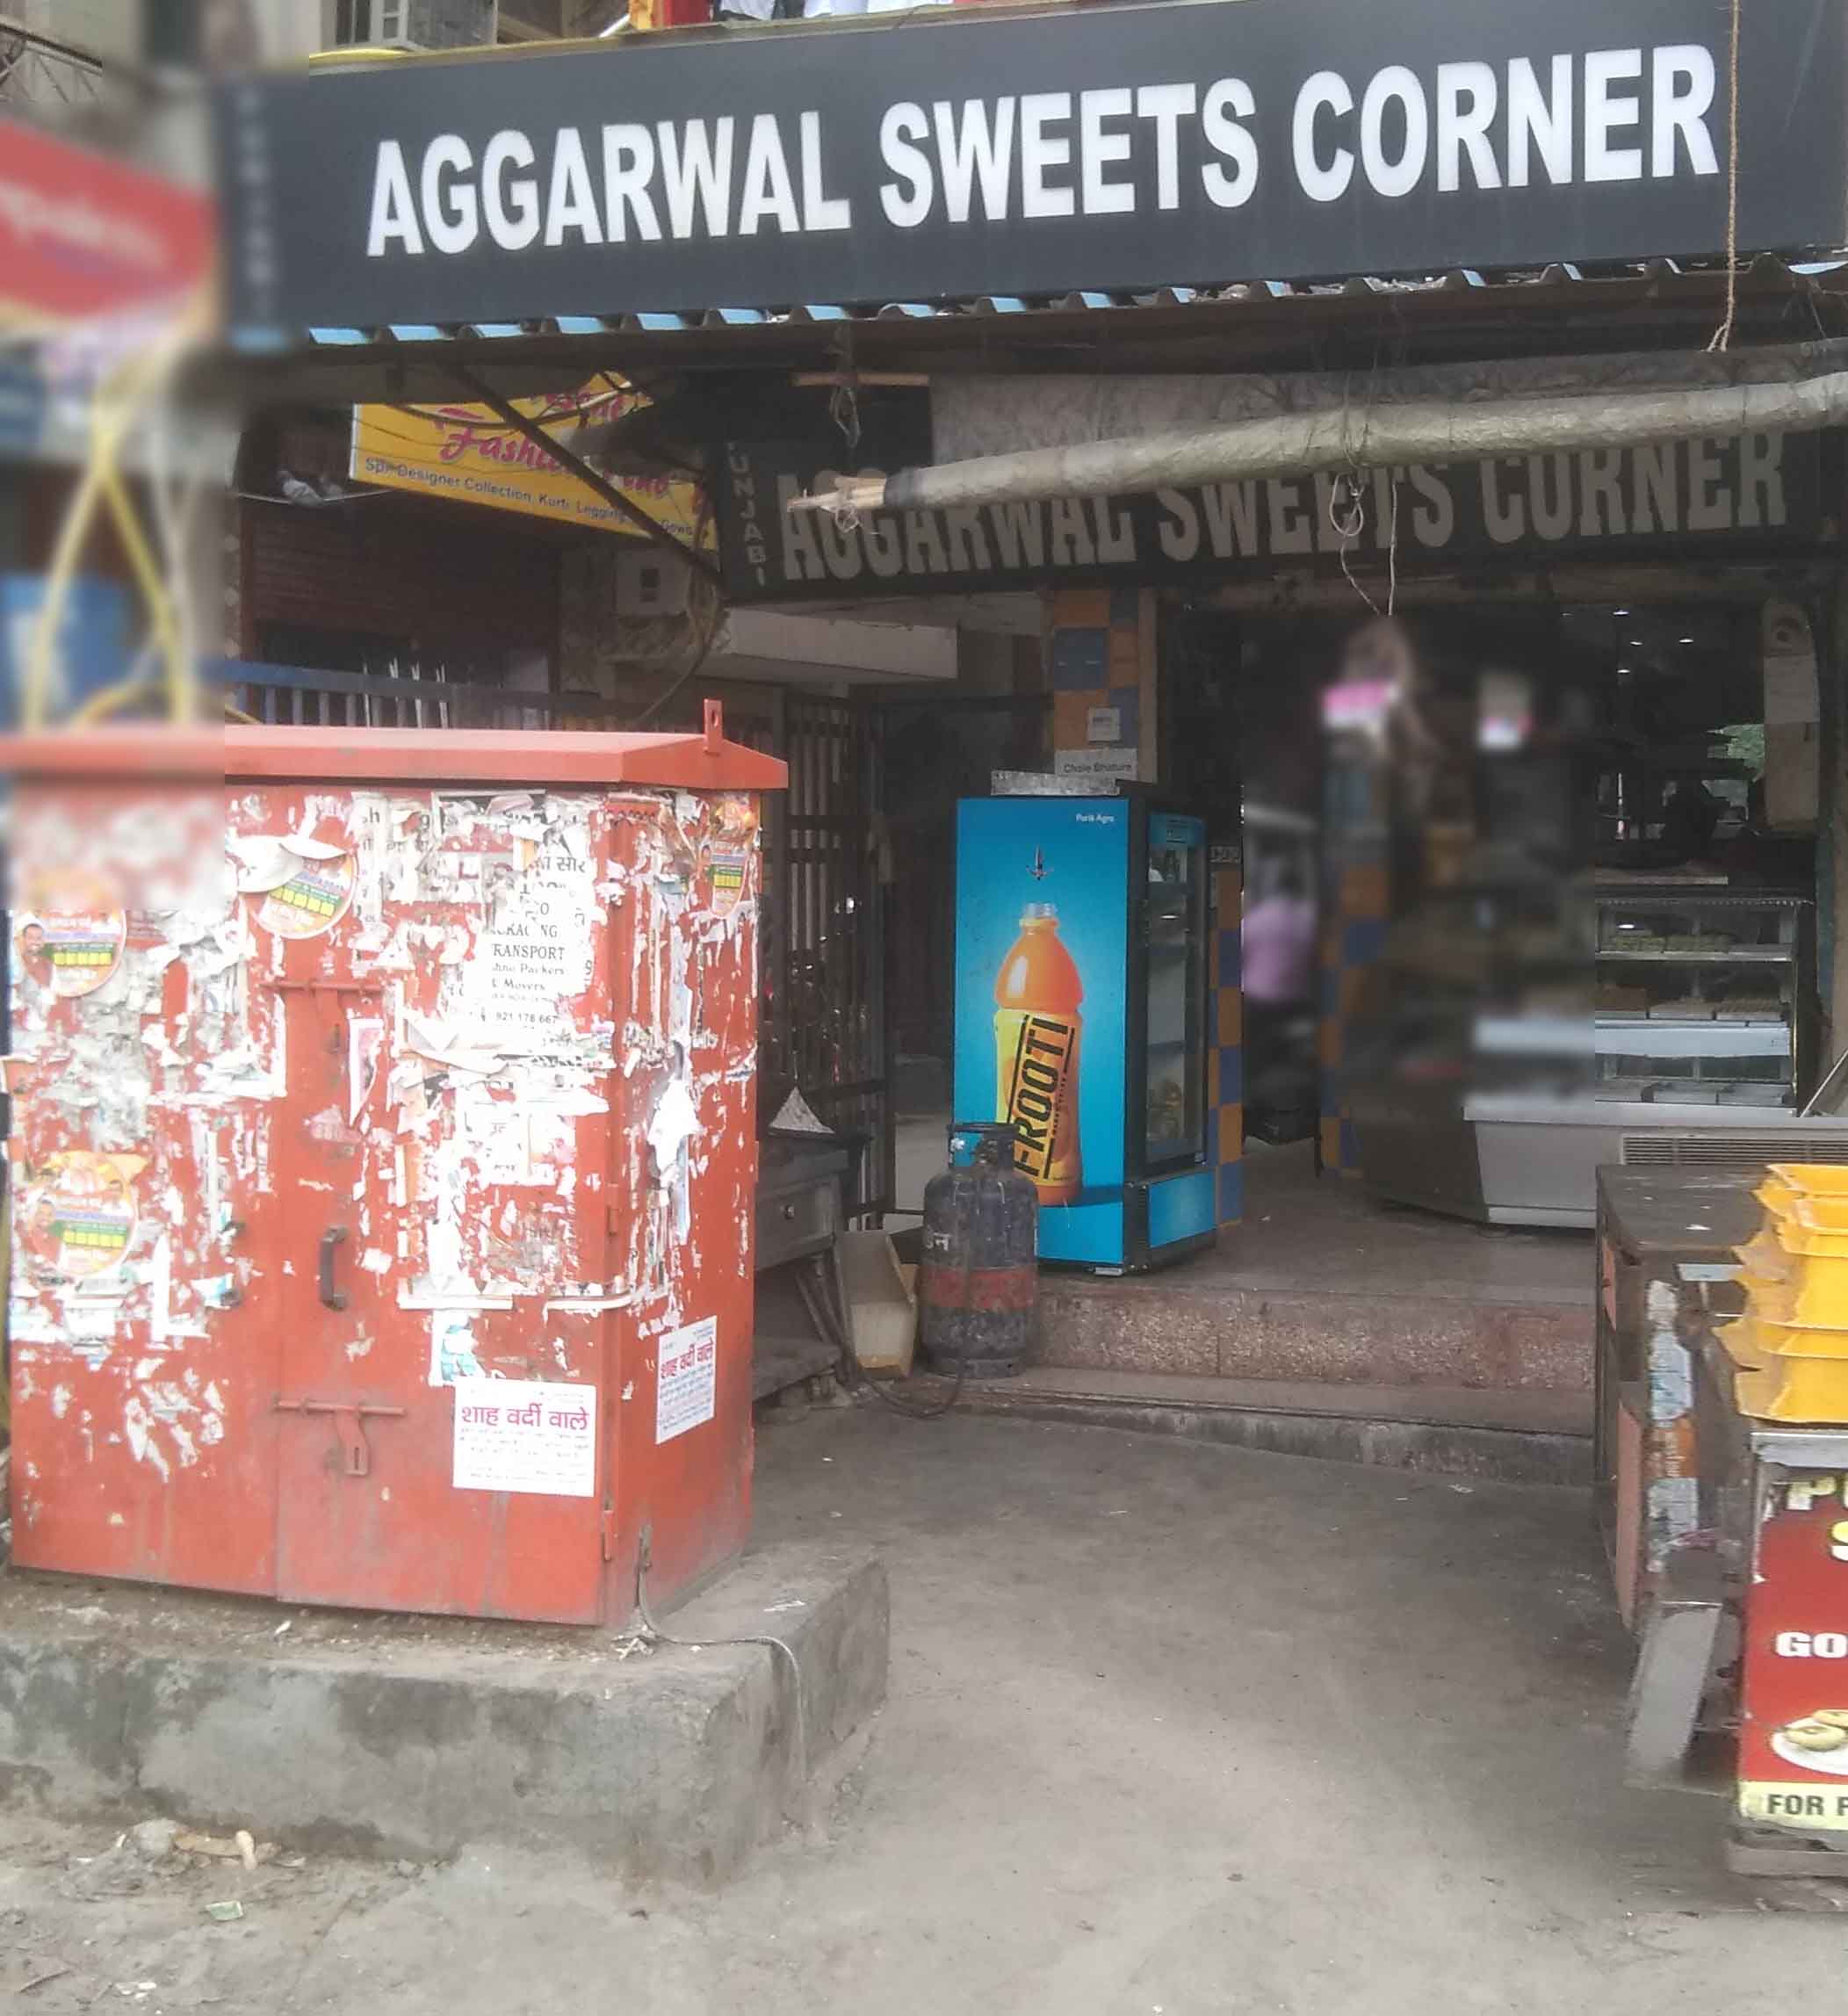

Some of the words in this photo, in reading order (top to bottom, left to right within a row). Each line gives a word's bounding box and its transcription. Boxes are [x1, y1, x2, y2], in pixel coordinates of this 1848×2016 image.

[366, 111, 851, 257] AGGARWAL
[880, 77, 1259, 228] SWEETS
[1293, 44, 1719, 202] CORNER
[397, 462, 459, 488] Designer
[493, 943, 565, 960] RANSPORT
[1013, 1017, 1069, 1177] FROOTI
[462, 1405, 500, 1427] शाह
[548, 1405, 589, 1430] वाले
[1767, 1794, 1824, 1816] FOR
